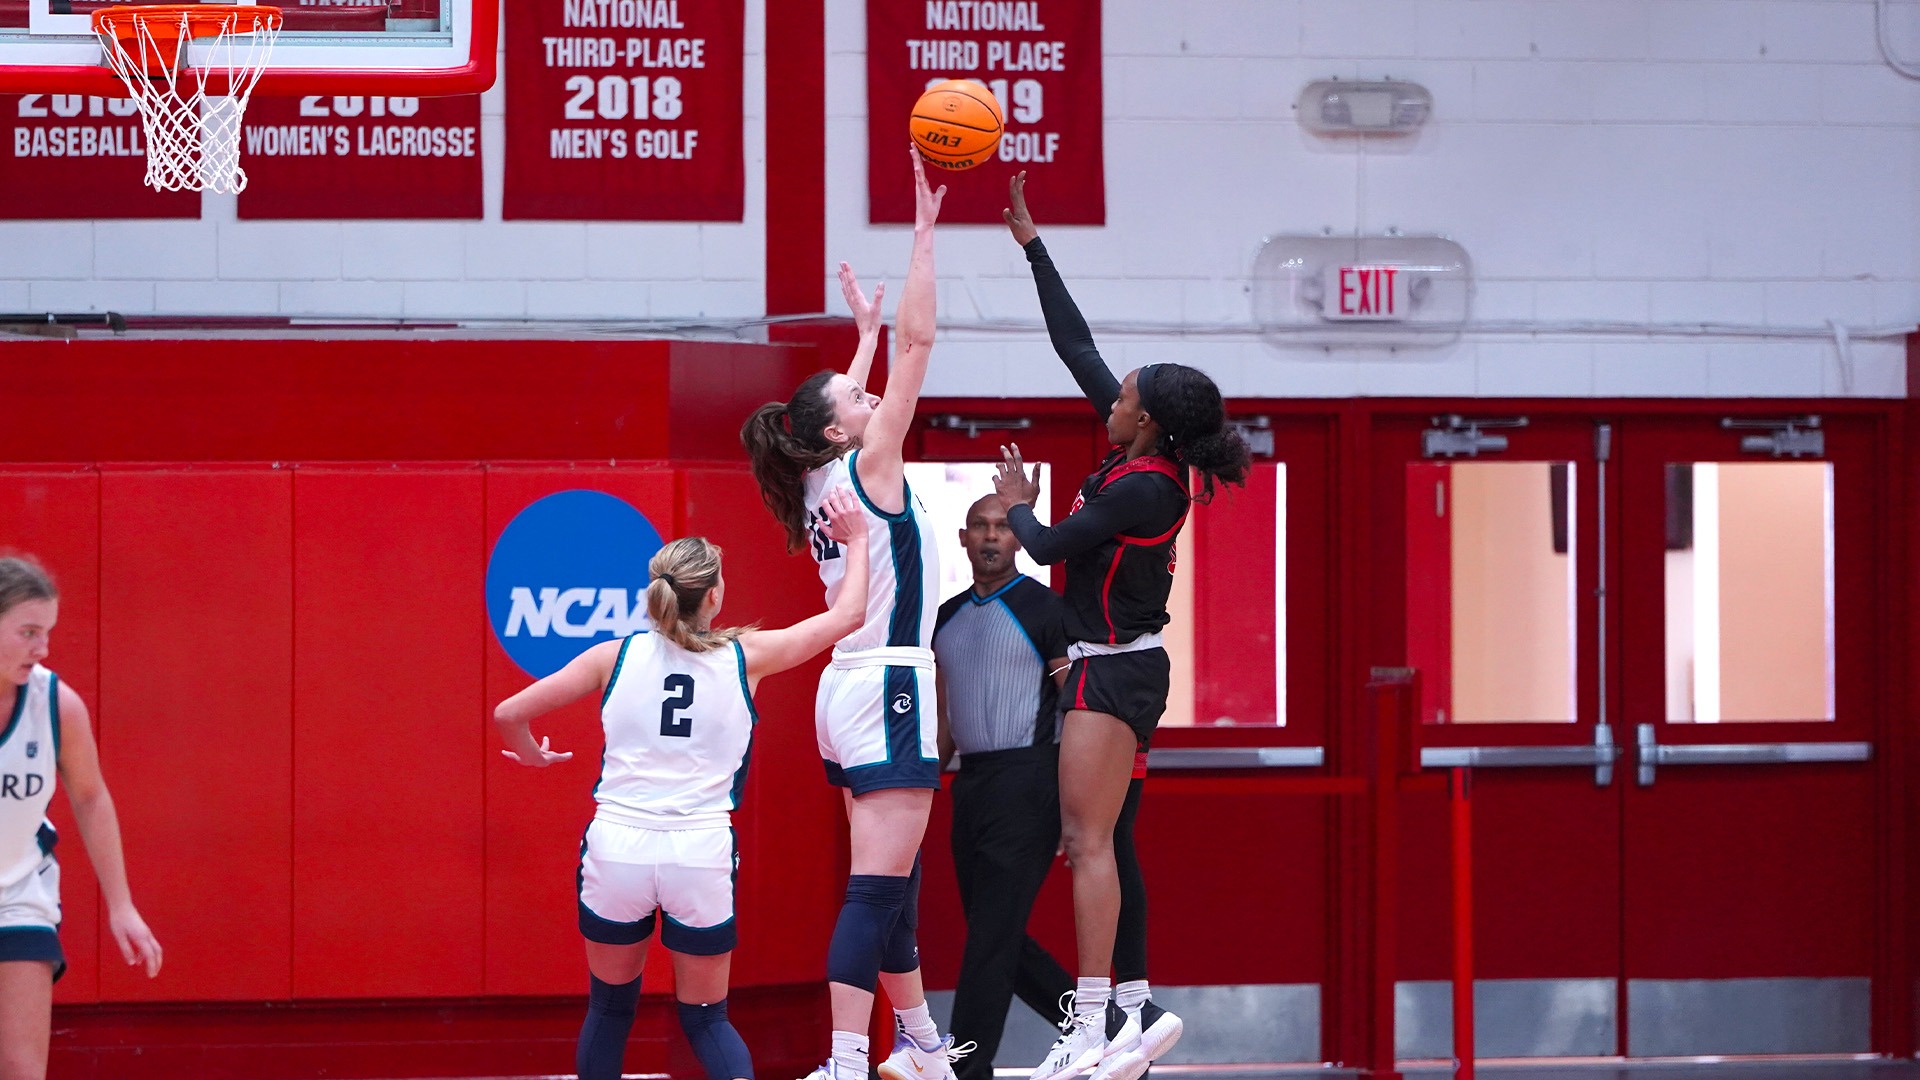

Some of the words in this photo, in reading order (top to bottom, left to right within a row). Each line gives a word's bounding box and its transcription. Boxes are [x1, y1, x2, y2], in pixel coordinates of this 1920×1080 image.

[563, 0, 684, 29] NATIONAL
[926, 0, 1044, 31] NATIONAL
[542, 37, 705, 68] THIRD-PLACE
[906, 40, 979, 70] THIRD
[987, 42, 1065, 71] PLACE
[564, 75, 683, 120] 2018
[14, 126, 145, 157] BASEBALL
[245, 125, 350, 156] WOMEN'S
[357, 126, 475, 158] LACROSSE
[550, 129, 628, 159] MEN'S
[635, 130, 698, 160] GOLF
[926, 131, 961, 147] EVO
[999, 133, 1059, 163] GOLF
[1339, 266, 1398, 315] EXIT
[660, 673, 695, 738] 2
